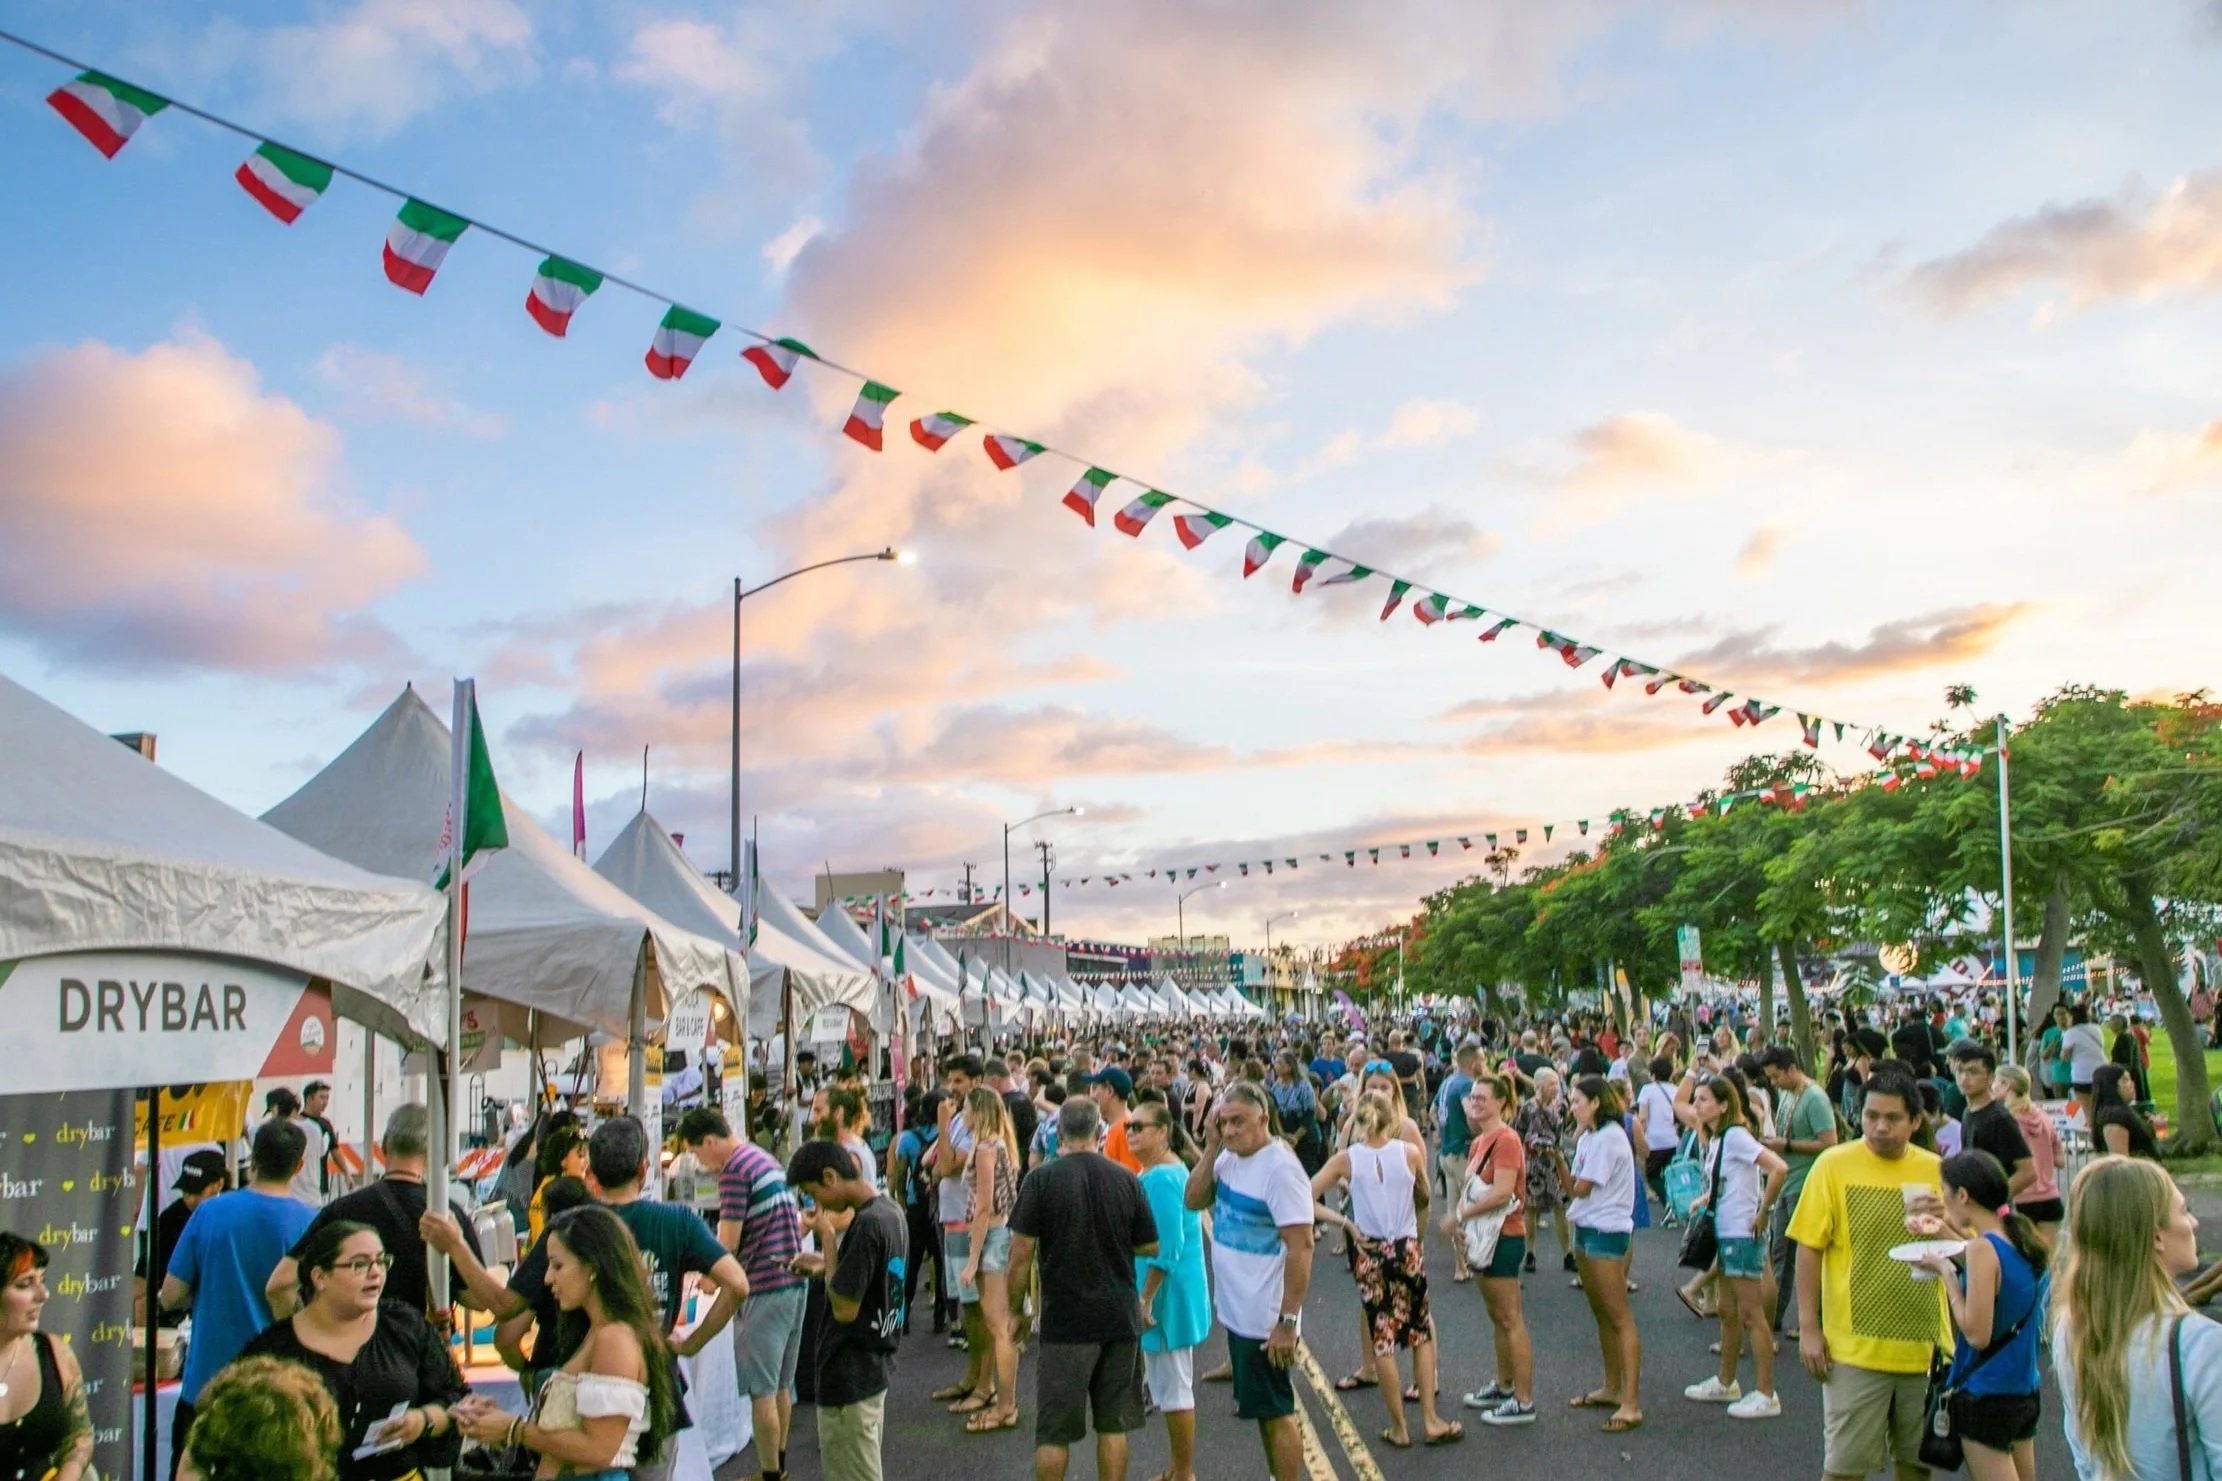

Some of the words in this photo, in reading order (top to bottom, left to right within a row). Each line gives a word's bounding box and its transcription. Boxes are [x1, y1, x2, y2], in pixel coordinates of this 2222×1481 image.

[59, 977, 247, 1032] DRYBAR
[55, 1120, 115, 1150] drybar
[0, 1171, 43, 1199] bar
[38, 1221, 98, 1252] drybar
[57, 1272, 120, 1302] drybar
